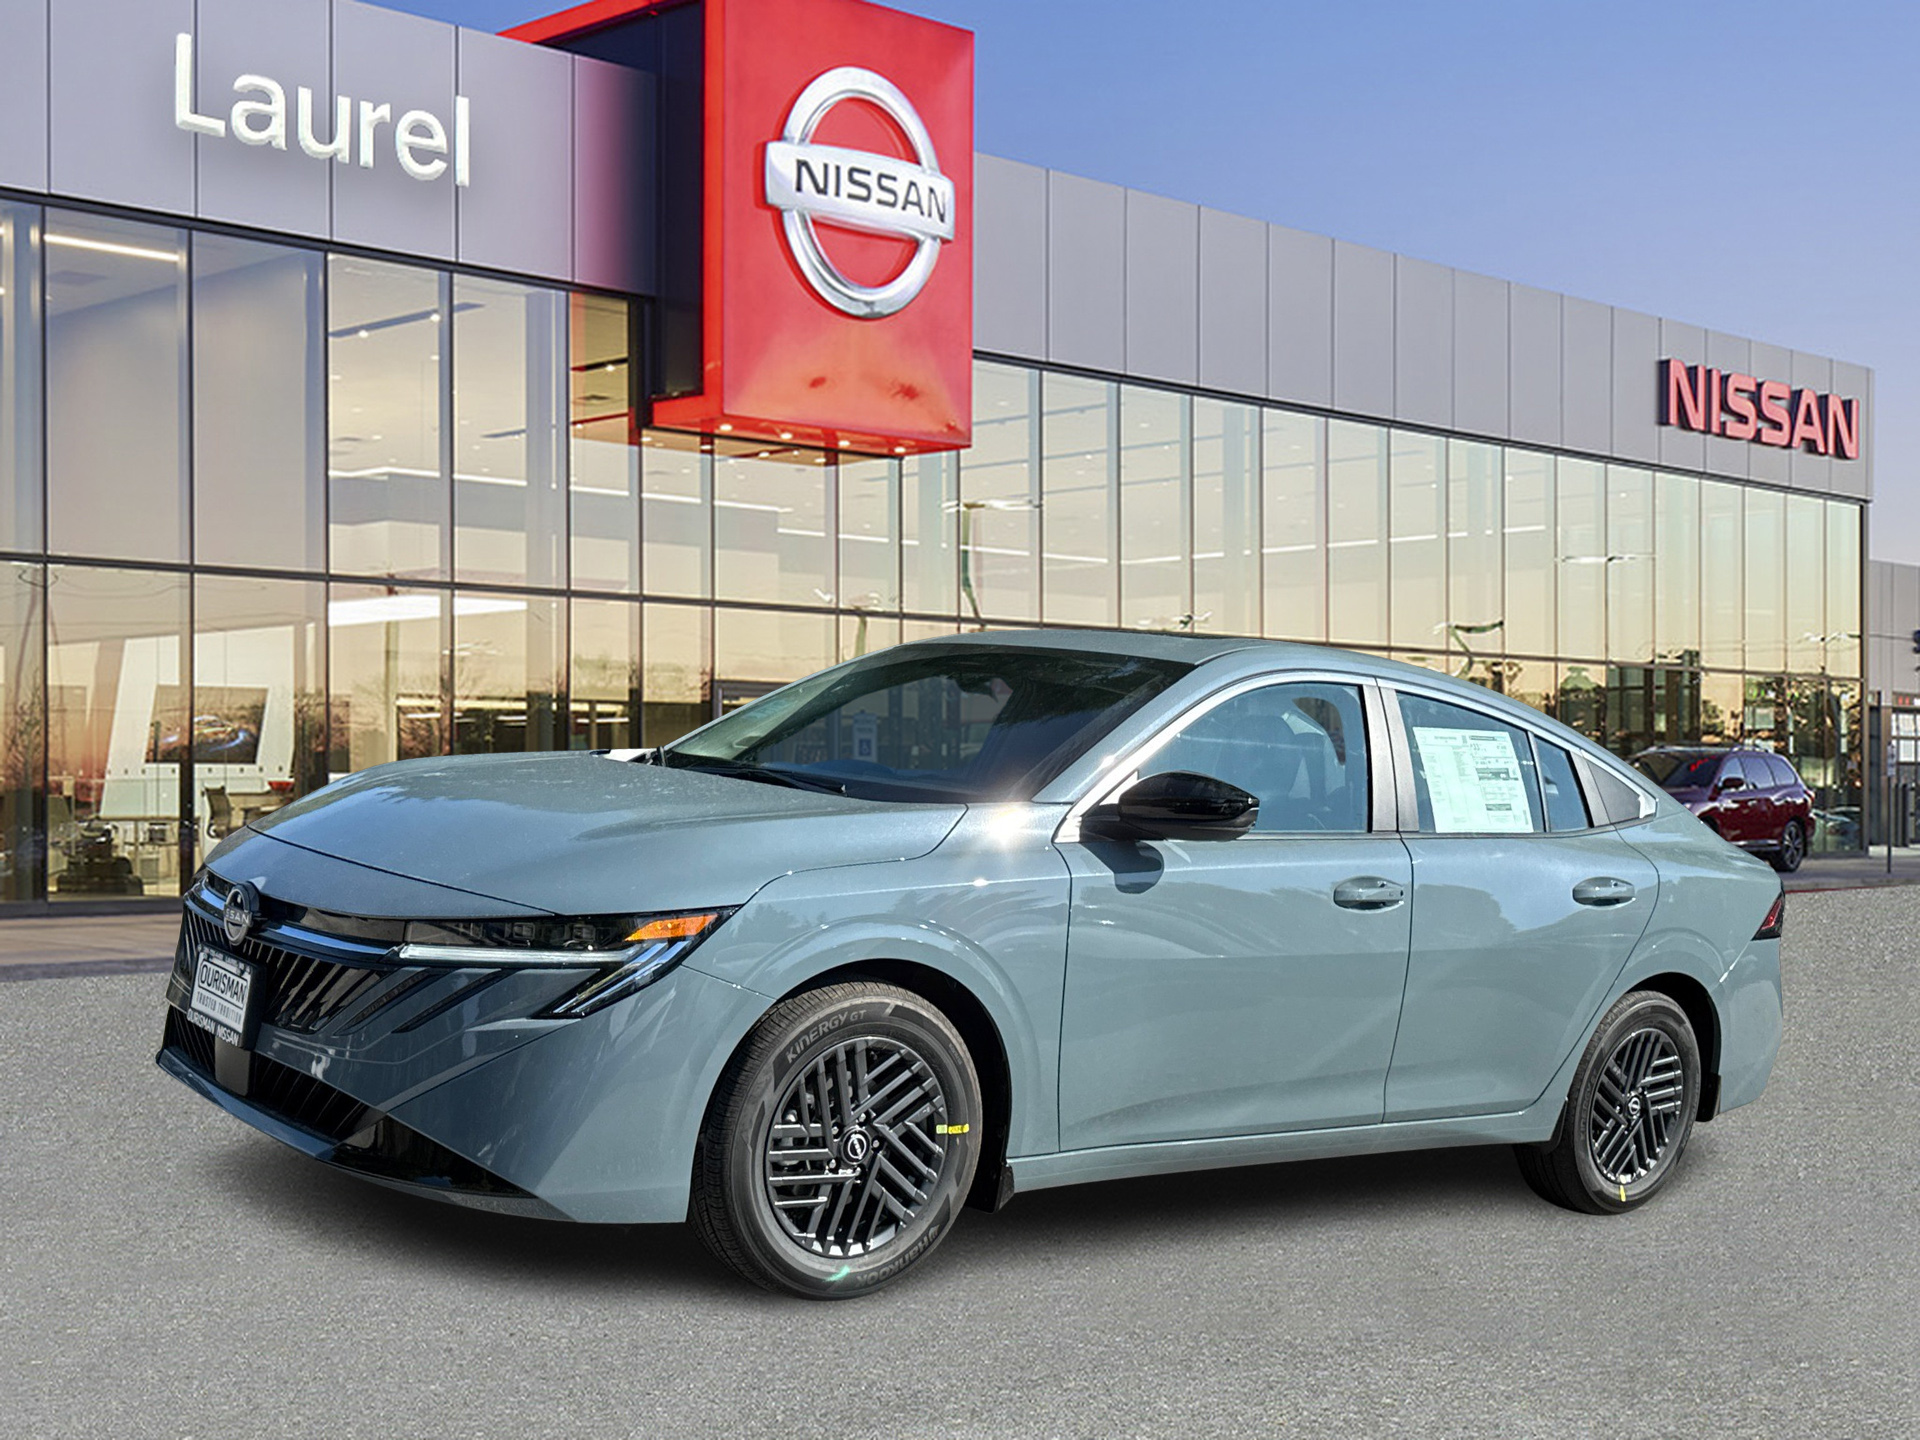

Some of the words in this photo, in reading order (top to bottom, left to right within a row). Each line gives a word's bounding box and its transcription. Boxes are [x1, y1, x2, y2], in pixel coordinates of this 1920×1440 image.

[175, 32, 470, 187] Laurel
[795, 158, 947, 224] NISSAN
[1657, 358, 1860, 460] NISSAN
[200, 963, 247, 1004] OURISMAN
[187, 1008, 216, 1035] OURISMAN
[216, 1024, 240, 1047] NISSAN
[849, 1009, 867, 1022] GT
